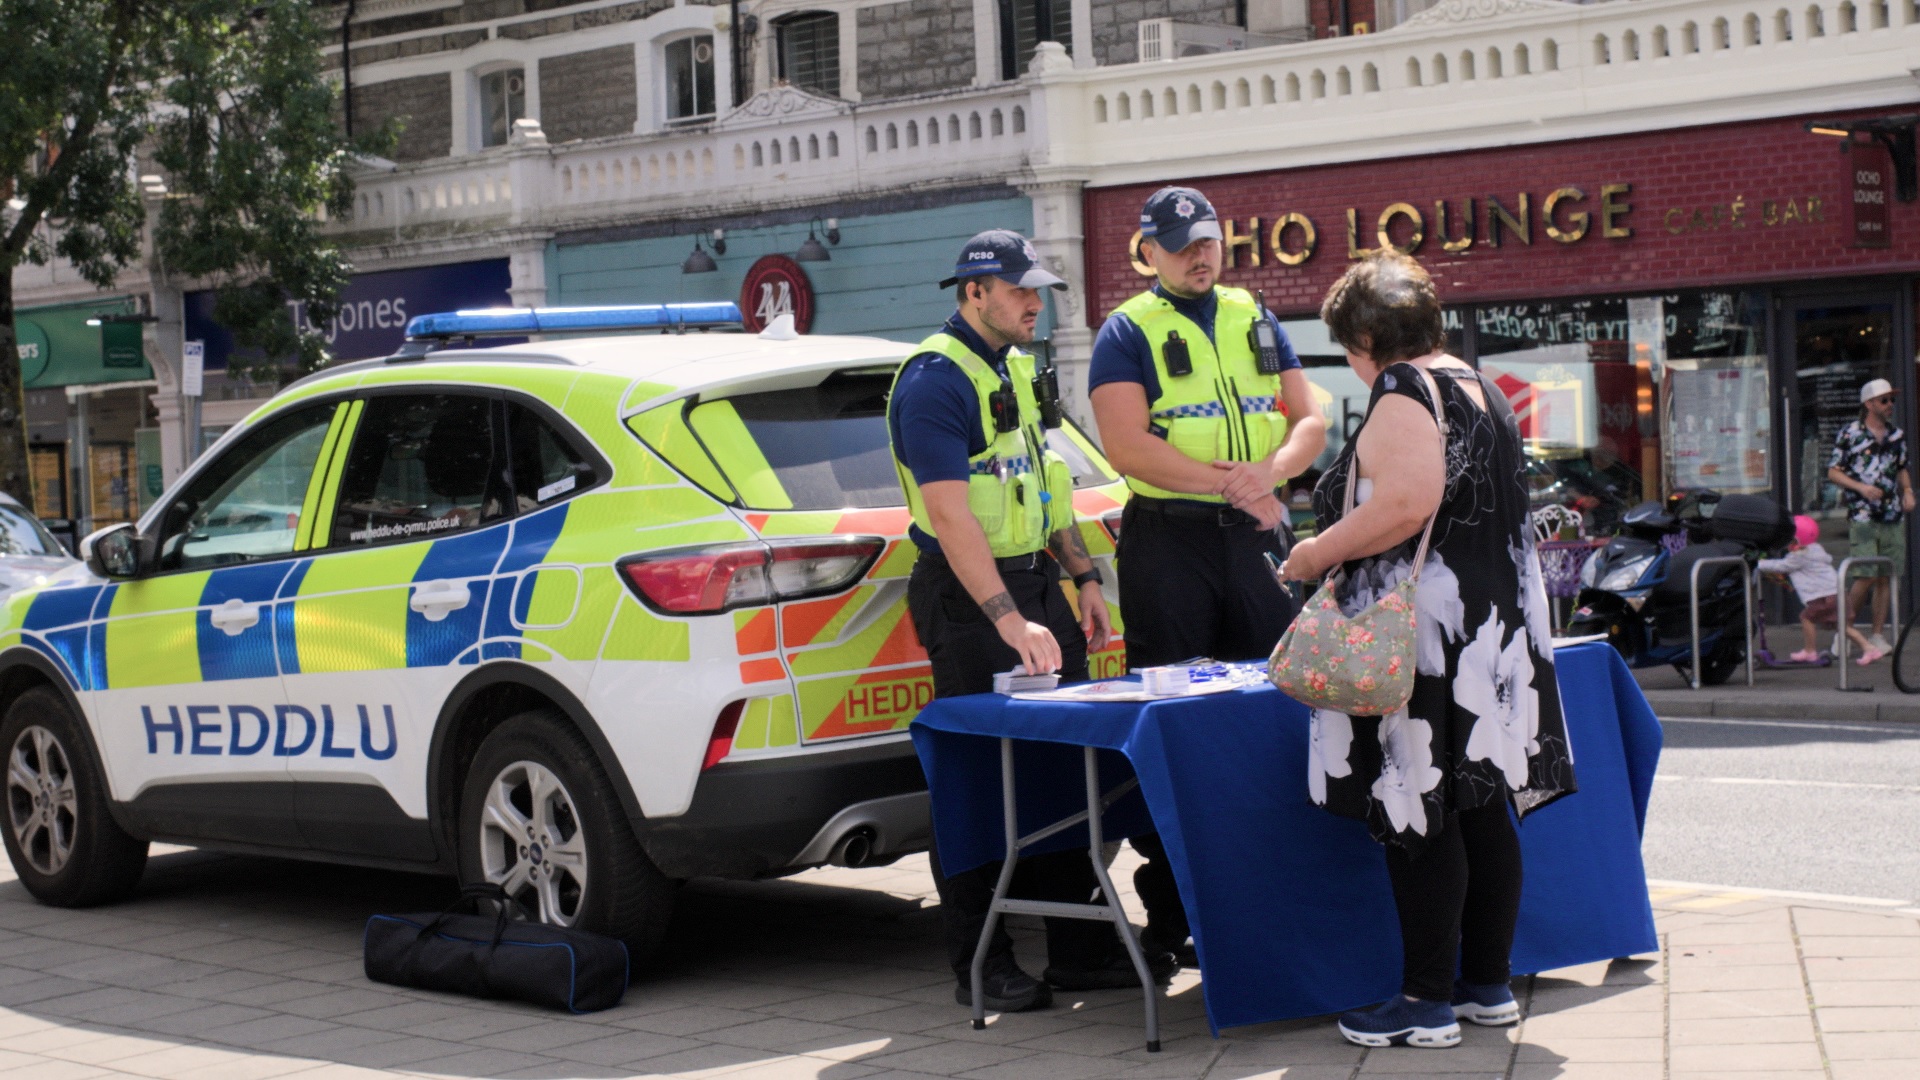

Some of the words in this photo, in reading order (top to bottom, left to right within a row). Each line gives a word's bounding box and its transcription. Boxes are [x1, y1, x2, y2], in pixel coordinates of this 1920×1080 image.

[1856, 170, 1881, 186] OCHO
[1853, 189, 1885, 205] LOUNGE
[1346, 182, 1632, 260] LOUNGE
[1663, 195, 1746, 235] CAFÉ
[1762, 195, 1825, 226] BAR
[968, 251, 995, 261] PCSO
[350, 515, 460, 541] www.heddlu-de-cymru.police.uk
[141, 703, 398, 761] HEDDLU
